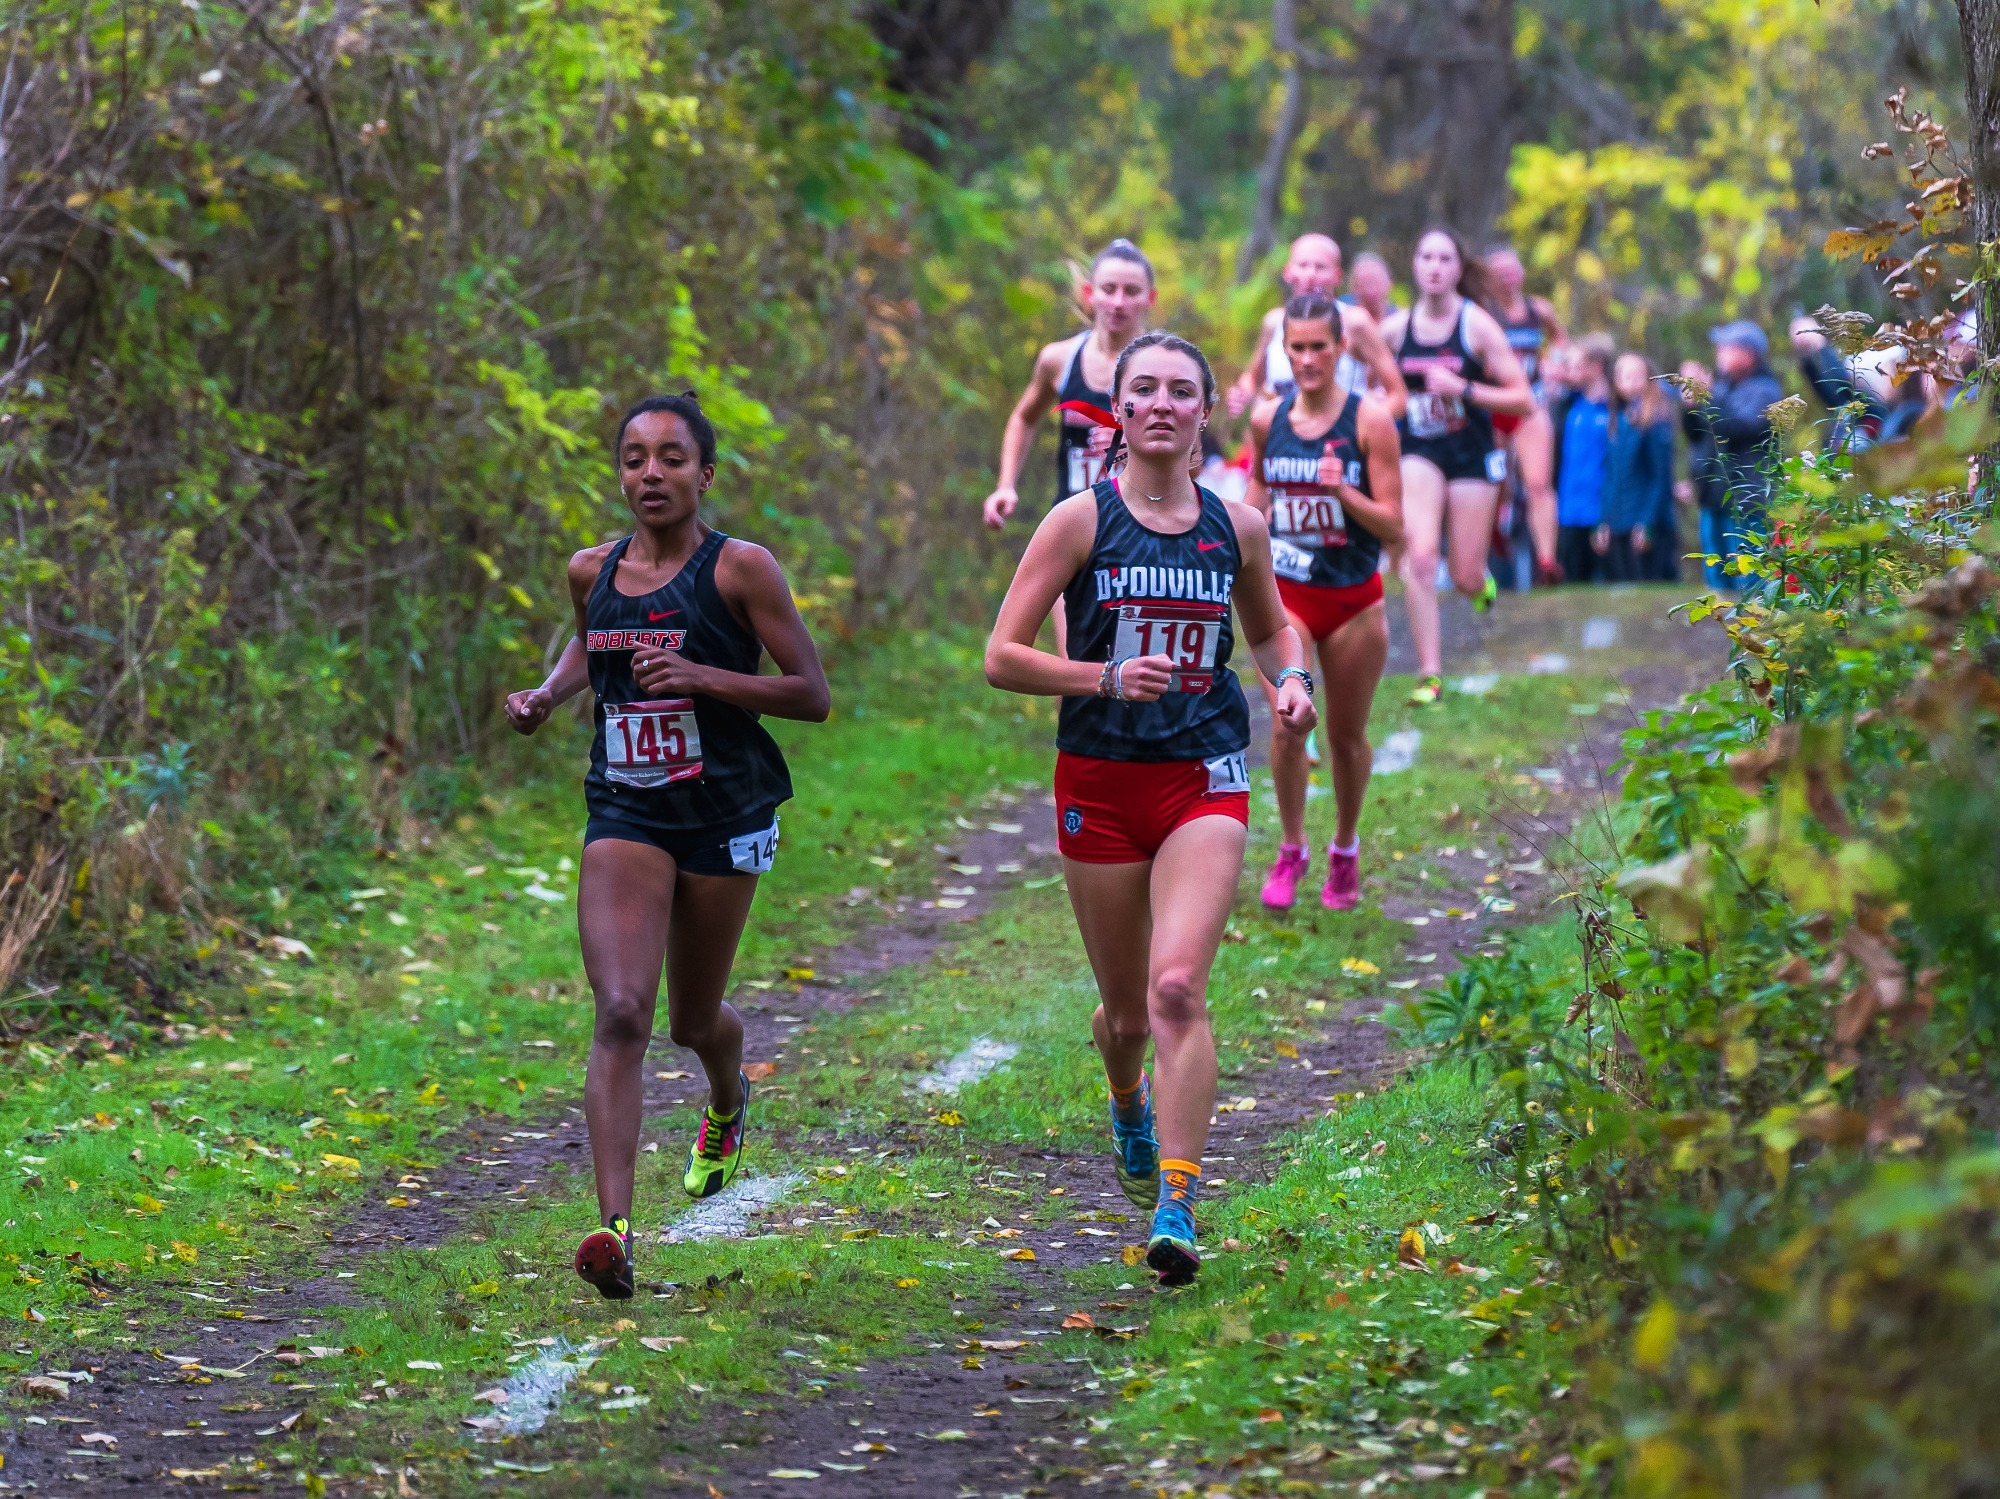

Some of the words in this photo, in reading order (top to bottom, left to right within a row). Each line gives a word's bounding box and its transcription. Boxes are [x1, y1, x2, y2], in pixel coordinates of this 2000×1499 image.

[1286, 501, 1334, 533] 120
[587, 629, 687, 651] ROBERTS
[1134, 620, 1206, 671] 119
[617, 714, 686, 766] 145
